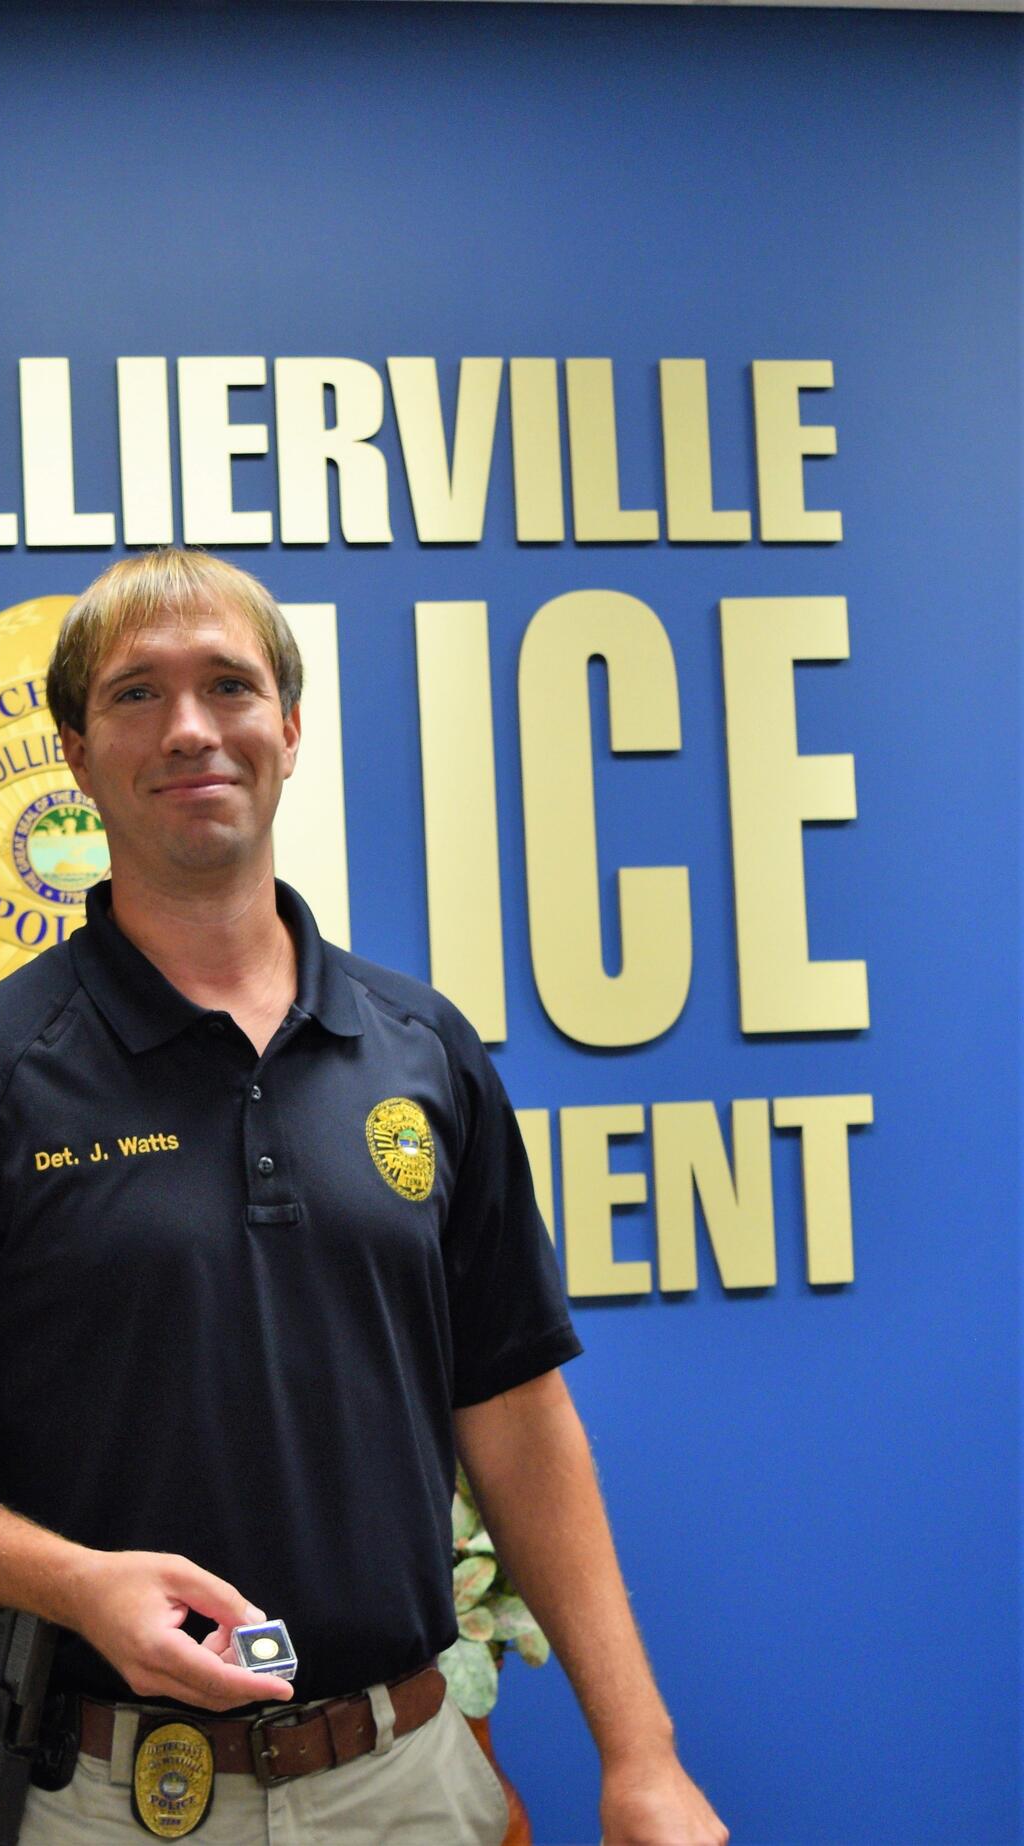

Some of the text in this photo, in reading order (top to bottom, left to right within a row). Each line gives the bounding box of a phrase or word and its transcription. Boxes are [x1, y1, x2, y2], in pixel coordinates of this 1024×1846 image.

[14, 806, 37, 835] SEAL
[50, 790, 71, 805] THE
[34, 1133, 180, 1171] Det. J. Watts
